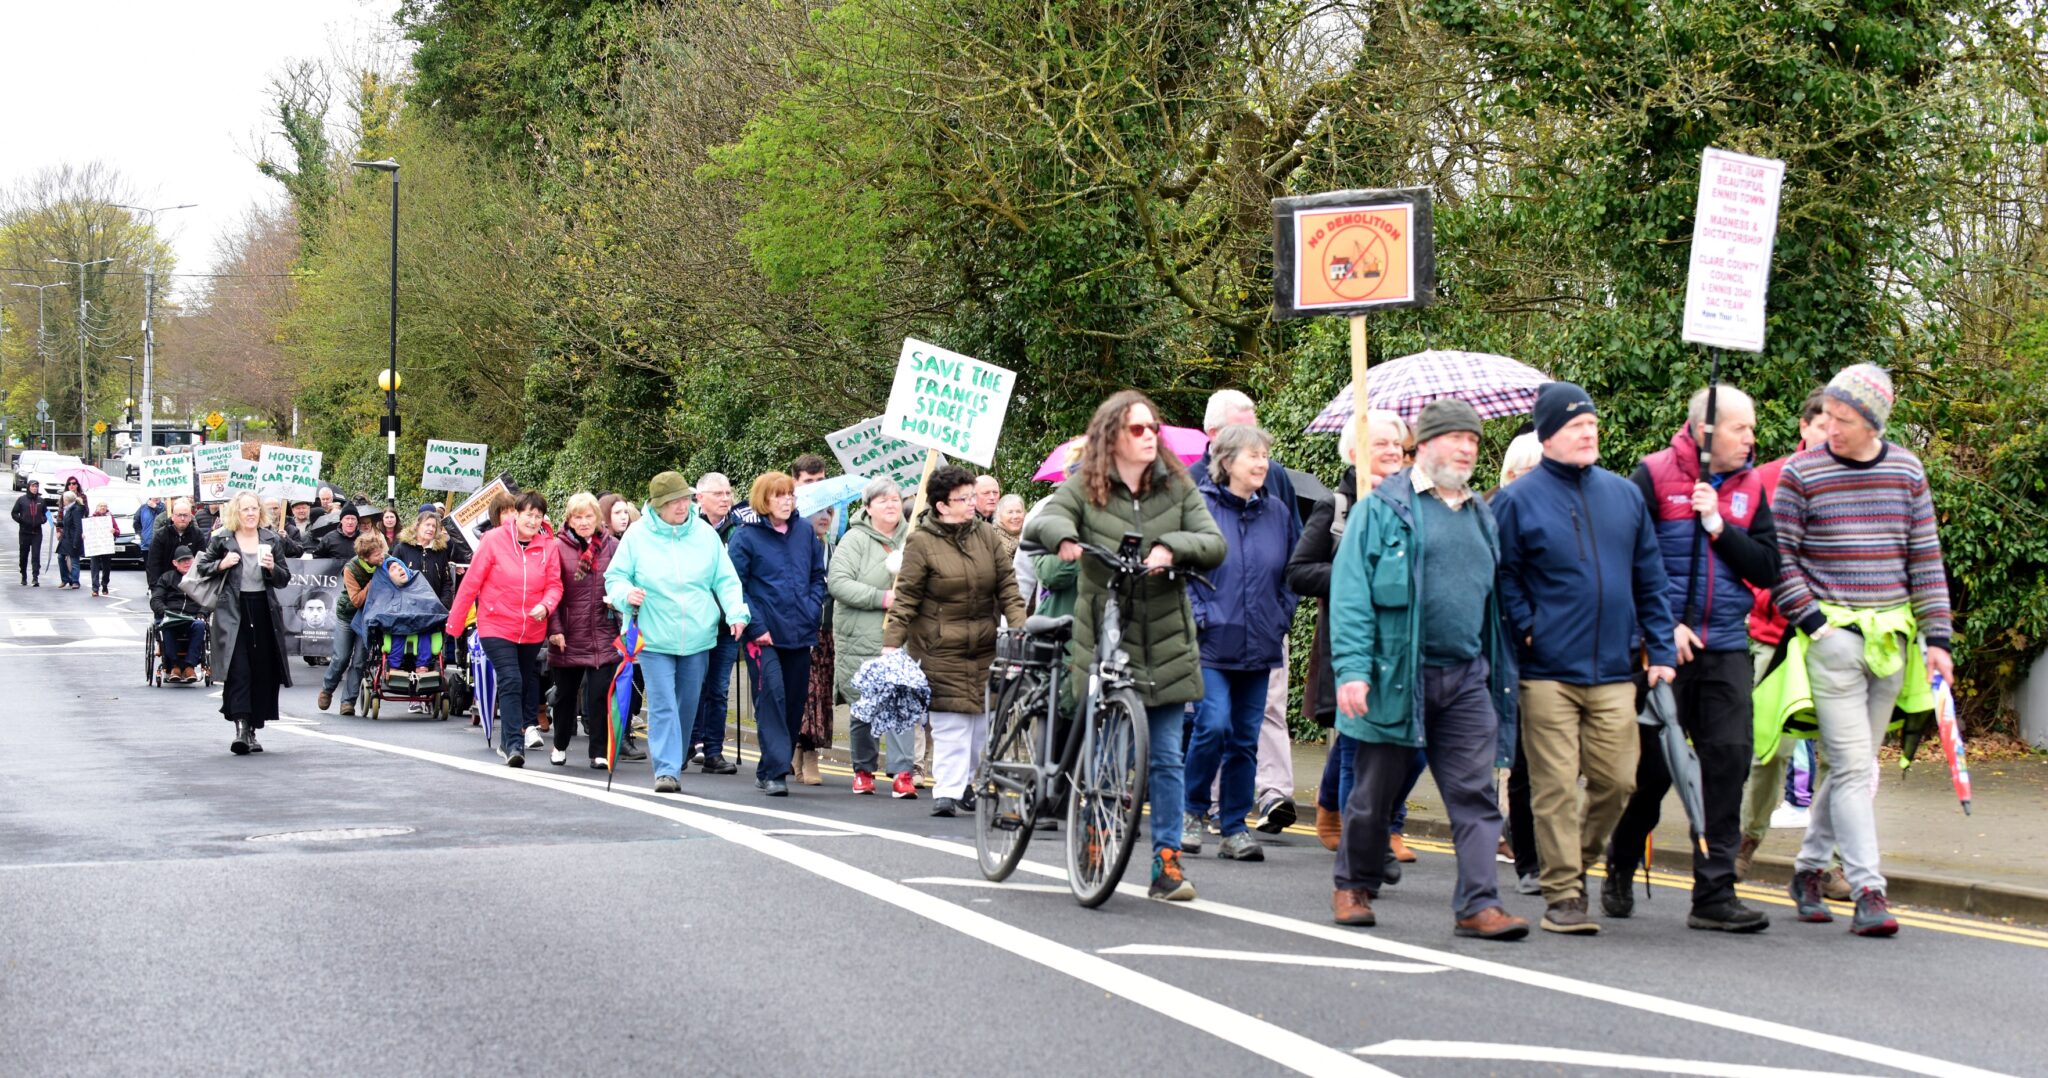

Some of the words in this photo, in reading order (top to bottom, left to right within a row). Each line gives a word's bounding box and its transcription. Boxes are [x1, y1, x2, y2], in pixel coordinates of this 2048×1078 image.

[1721, 163, 1743, 175] SAVE
[1745, 167, 1765, 178] OUR
[1716, 175, 1764, 193] BEAUTIFUL
[1711, 187, 1737, 201] ENNIS
[1740, 193, 1766, 206] TOWN
[1710, 214, 1749, 231] MADNESS
[1308, 229, 1325, 249] NO
[1326, 213, 1401, 242] DEMOLITION
[1702, 227, 1763, 246] DICTATORSHIP
[1699, 254, 1725, 267] CLARE
[1727, 259, 1760, 272] COUNTY
[1710, 270, 1744, 285] COUNCIL
[1708, 283, 1732, 296] ENNIS
[1723, 299, 1744, 310] TEAM
[910, 351, 964, 382] SAVE
[972, 365, 1003, 393] THE
[914, 376, 988, 413] FRANCIS
[914, 396, 978, 429] STREET
[901, 415, 972, 453] HOUSES
[268, 451, 313, 465] HOUSES
[430, 444, 480, 457] HOUSING
[852, 448, 881, 467] CAR
[144, 459, 163, 469] YOU
[153, 466, 181, 478] PARK
[276, 464, 298, 472] NOT
[302, 465, 310, 473] A
[427, 465, 451, 475] CAR
[455, 467, 483, 478] PARK
[860, 449, 929, 479] OCIALIS
[146, 479, 156, 488] A
[158, 475, 188, 487] HOUSE
[230, 472, 257, 483] PURPO
